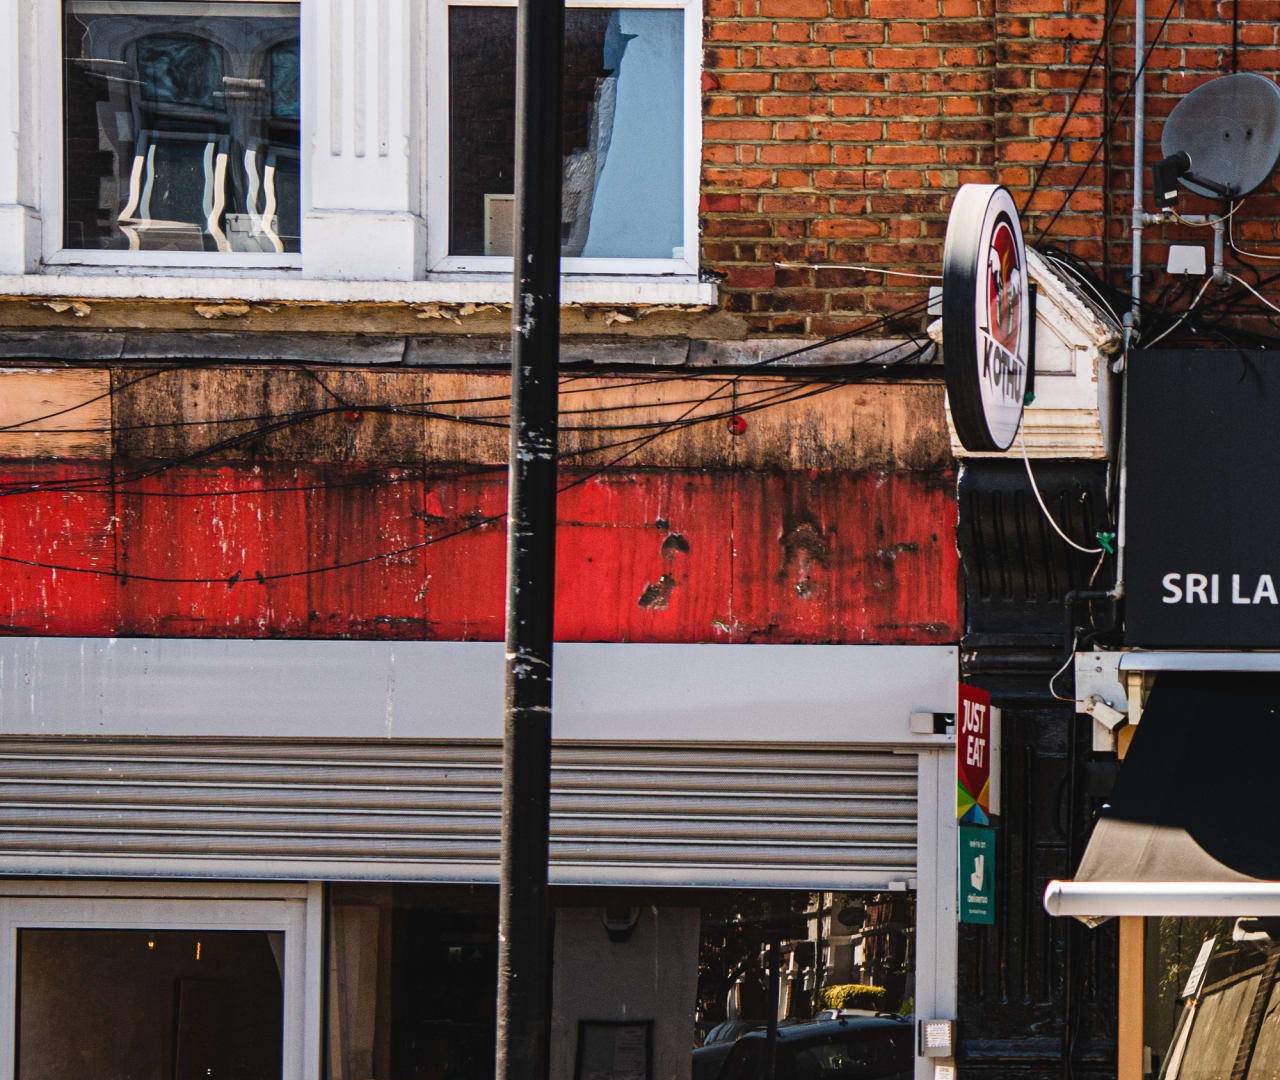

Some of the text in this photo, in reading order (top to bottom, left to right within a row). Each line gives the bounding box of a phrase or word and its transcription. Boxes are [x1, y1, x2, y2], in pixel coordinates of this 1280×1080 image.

[983, 335, 1023, 404] KOTHU
[1161, 573, 1219, 606] SRI
[962, 699, 986, 734] JUST
[967, 735, 986, 769] EAT
